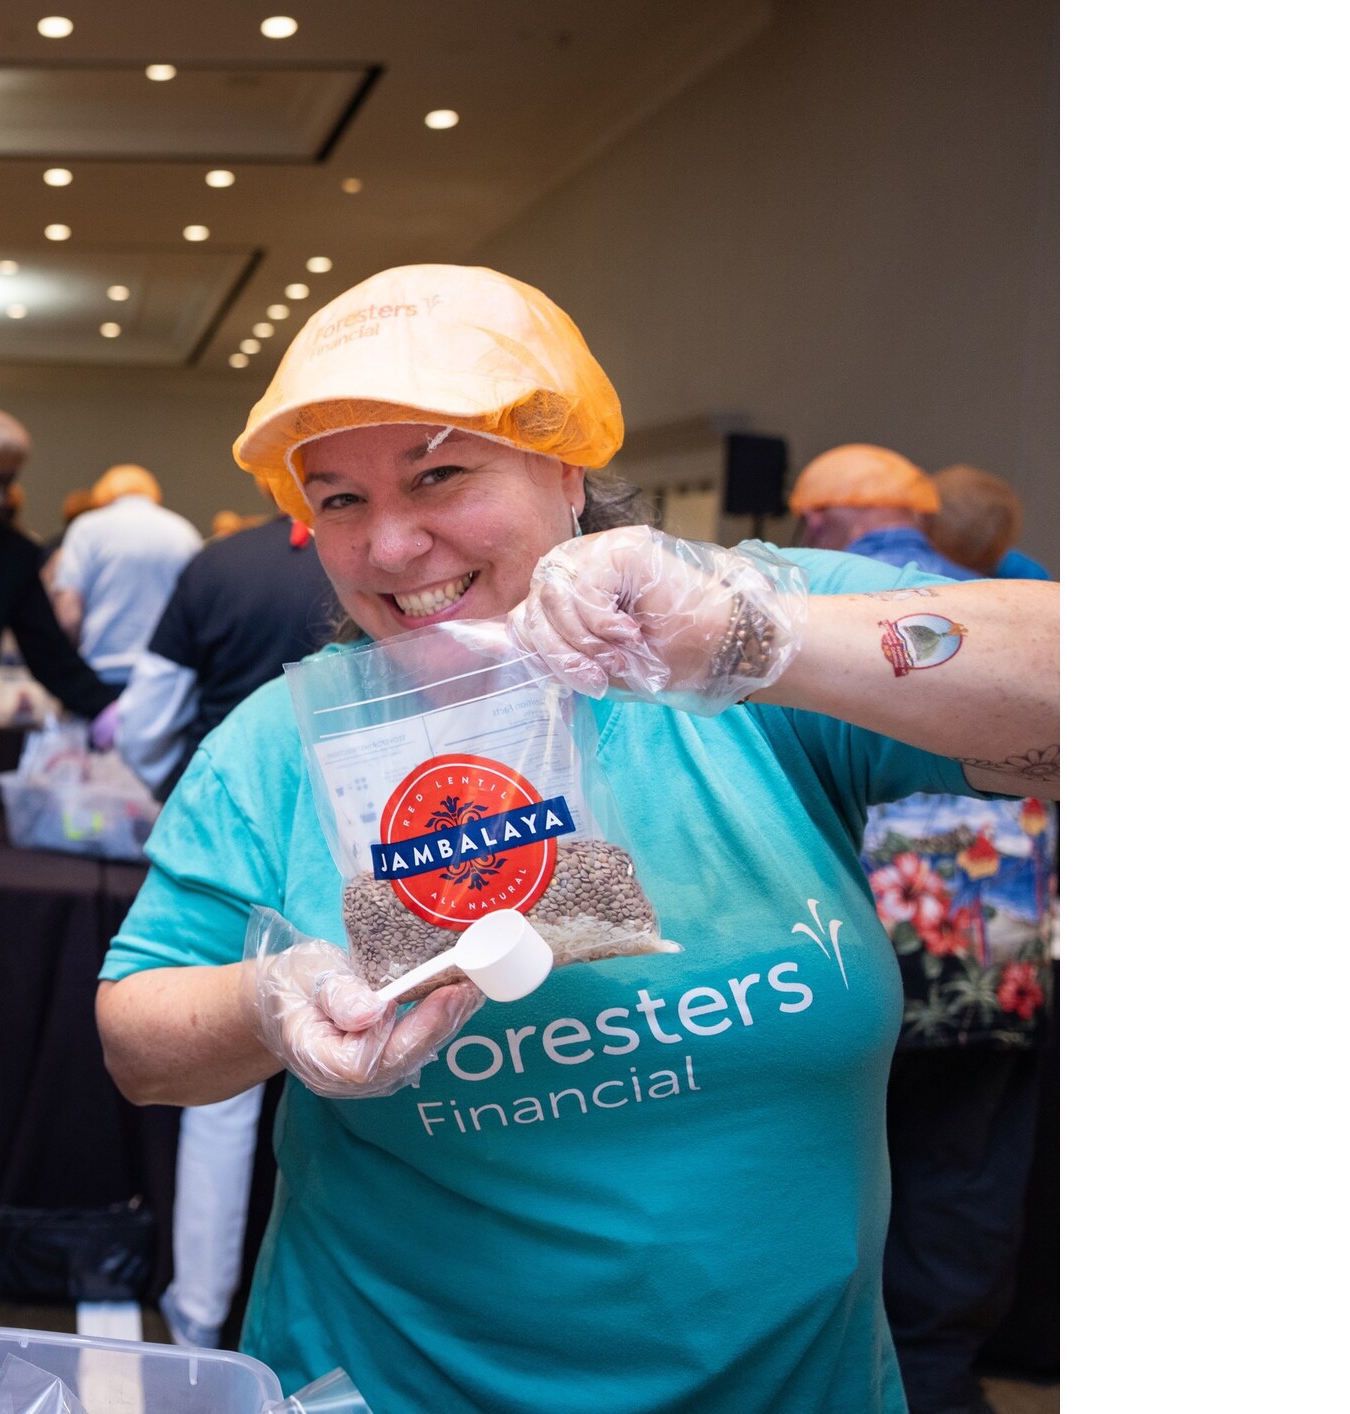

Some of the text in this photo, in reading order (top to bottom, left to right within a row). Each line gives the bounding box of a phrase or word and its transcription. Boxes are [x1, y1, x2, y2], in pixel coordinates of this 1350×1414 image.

[403, 776, 509, 827] RED LENTIL
[381, 809, 564, 872] JAMBALAYA
[430, 868, 527, 910] ALL NATURAL
[410, 962, 814, 1089] oresters
[416, 1055, 701, 1137] Financial
